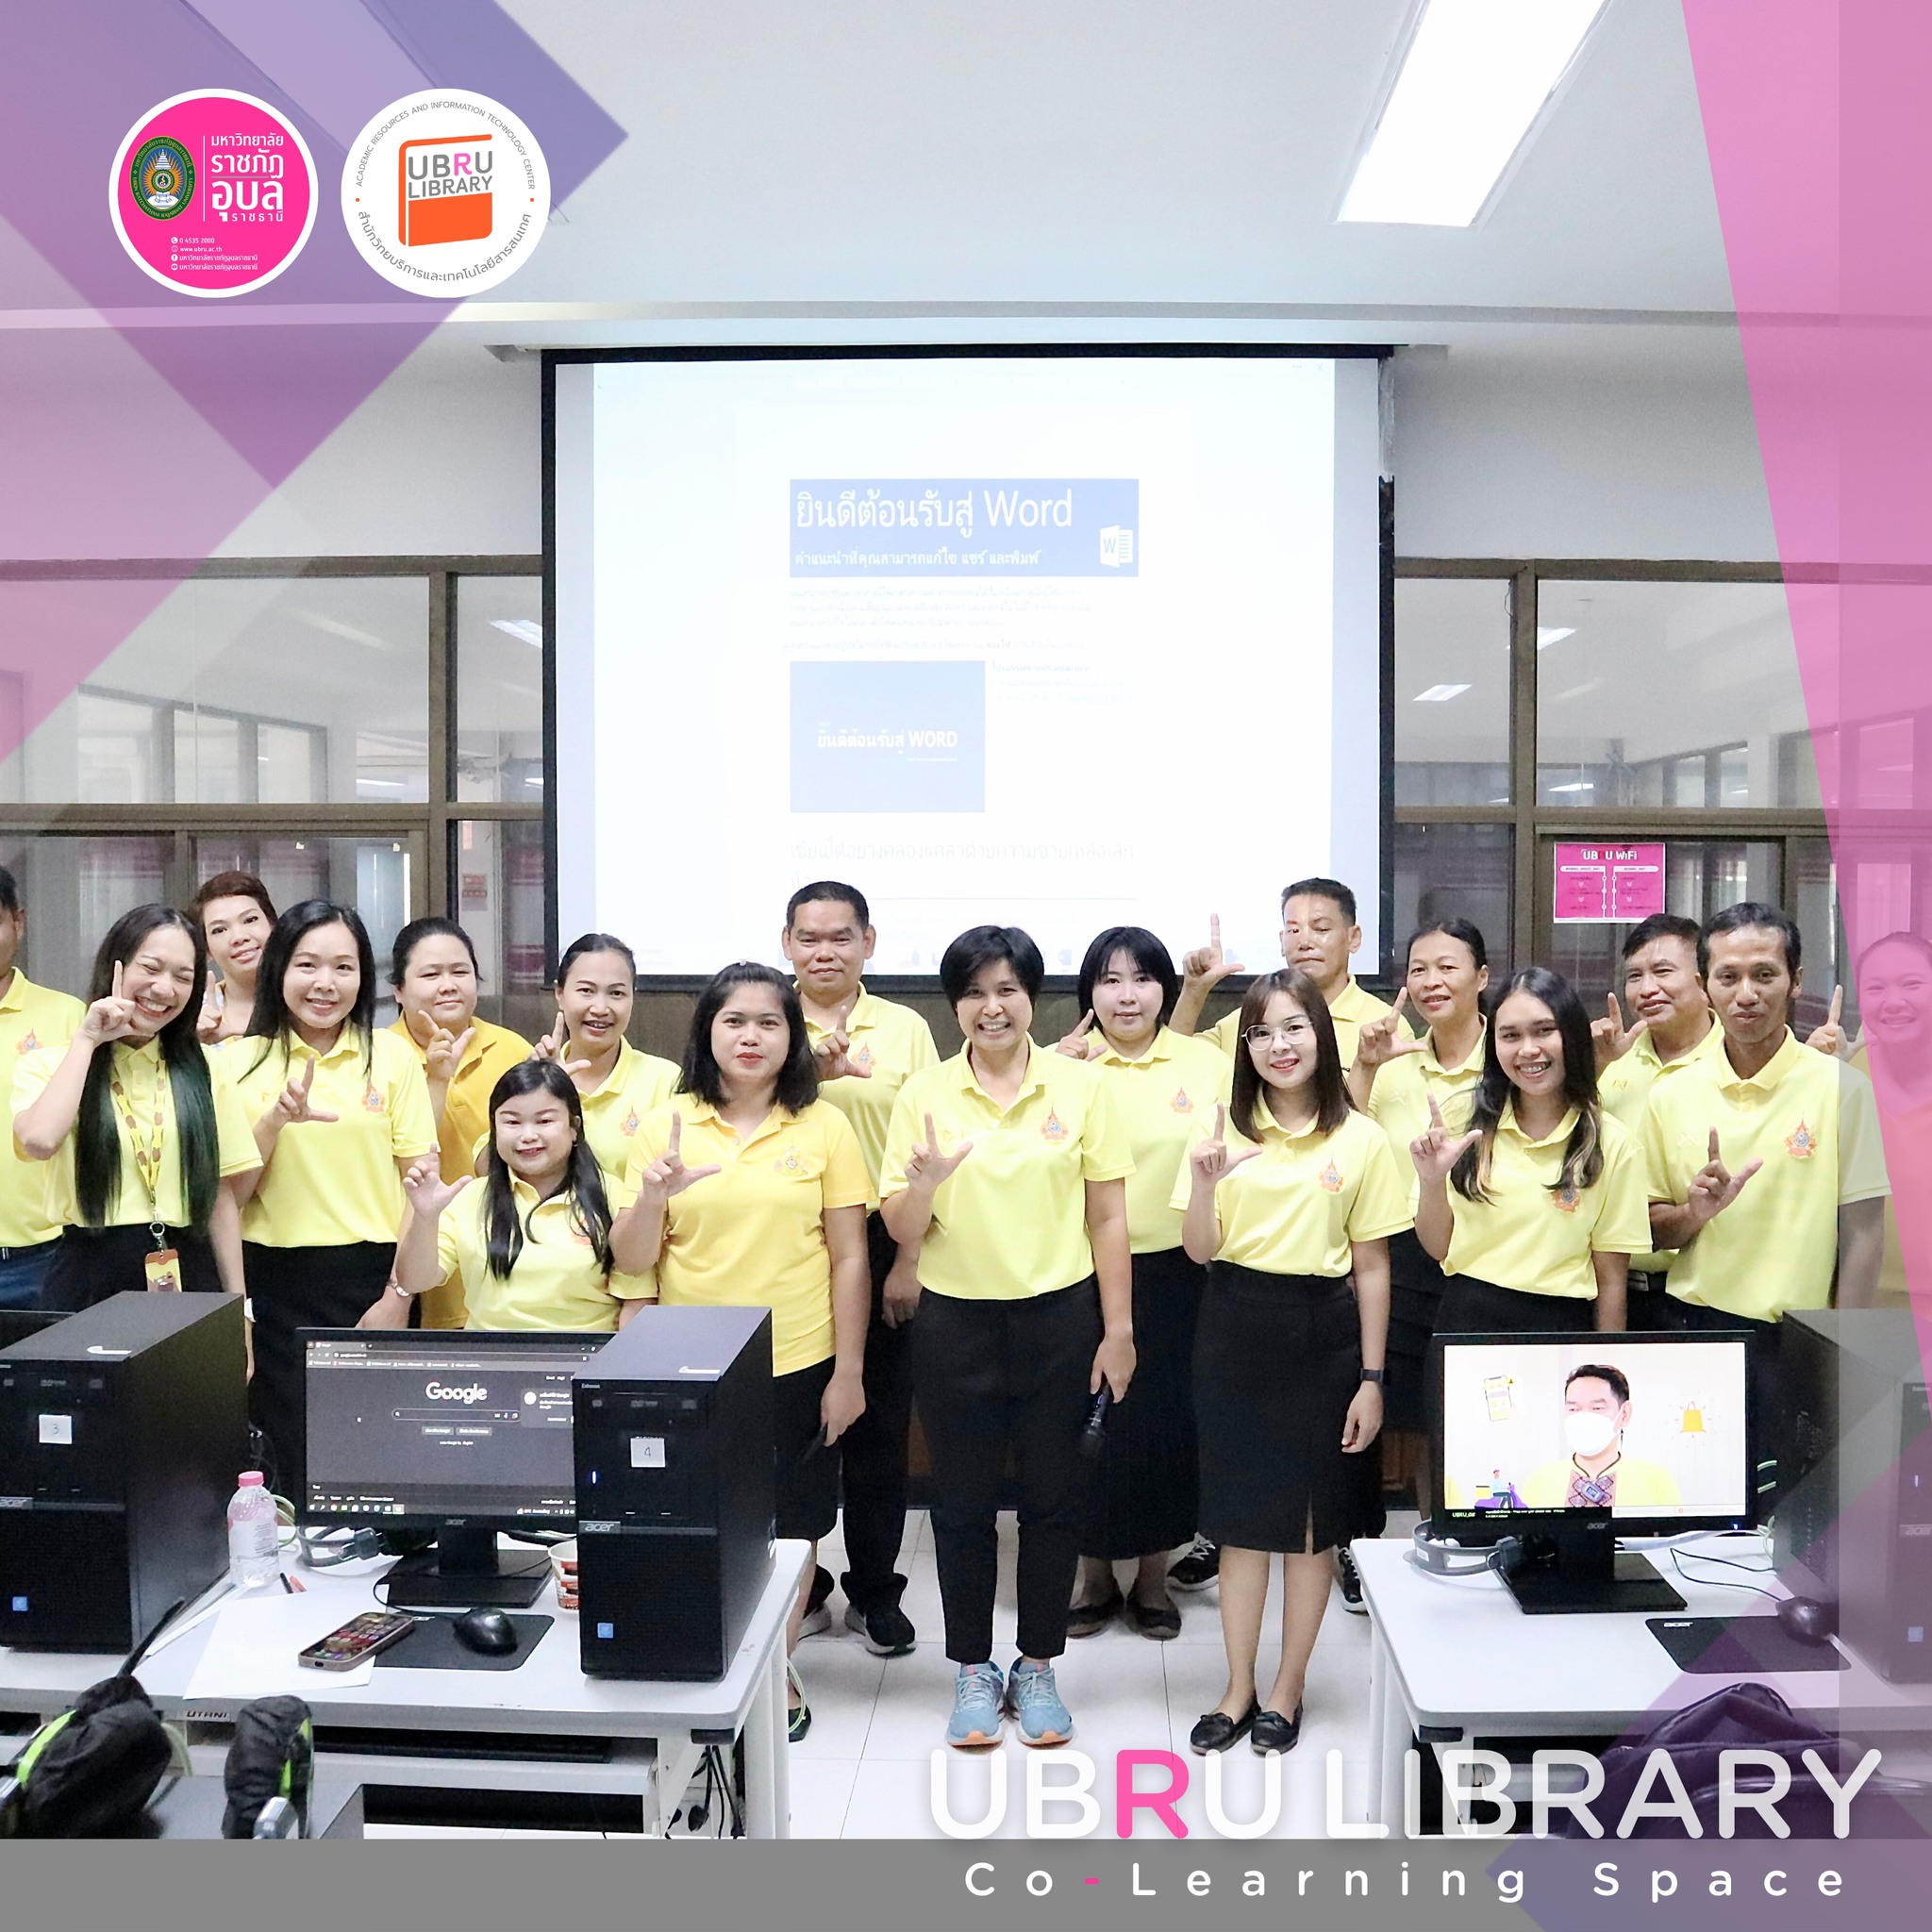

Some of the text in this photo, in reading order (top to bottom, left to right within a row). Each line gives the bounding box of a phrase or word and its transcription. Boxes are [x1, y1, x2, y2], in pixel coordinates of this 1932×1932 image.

[796, 489, 1073, 538] ยินดีต้อนรับสู่ Word
[908, 730, 958, 748] WORD
[1615, 850, 1638, 860] WiFi
[425, 1381, 488, 1405] Google
[585, 1523, 614, 1532] acer
